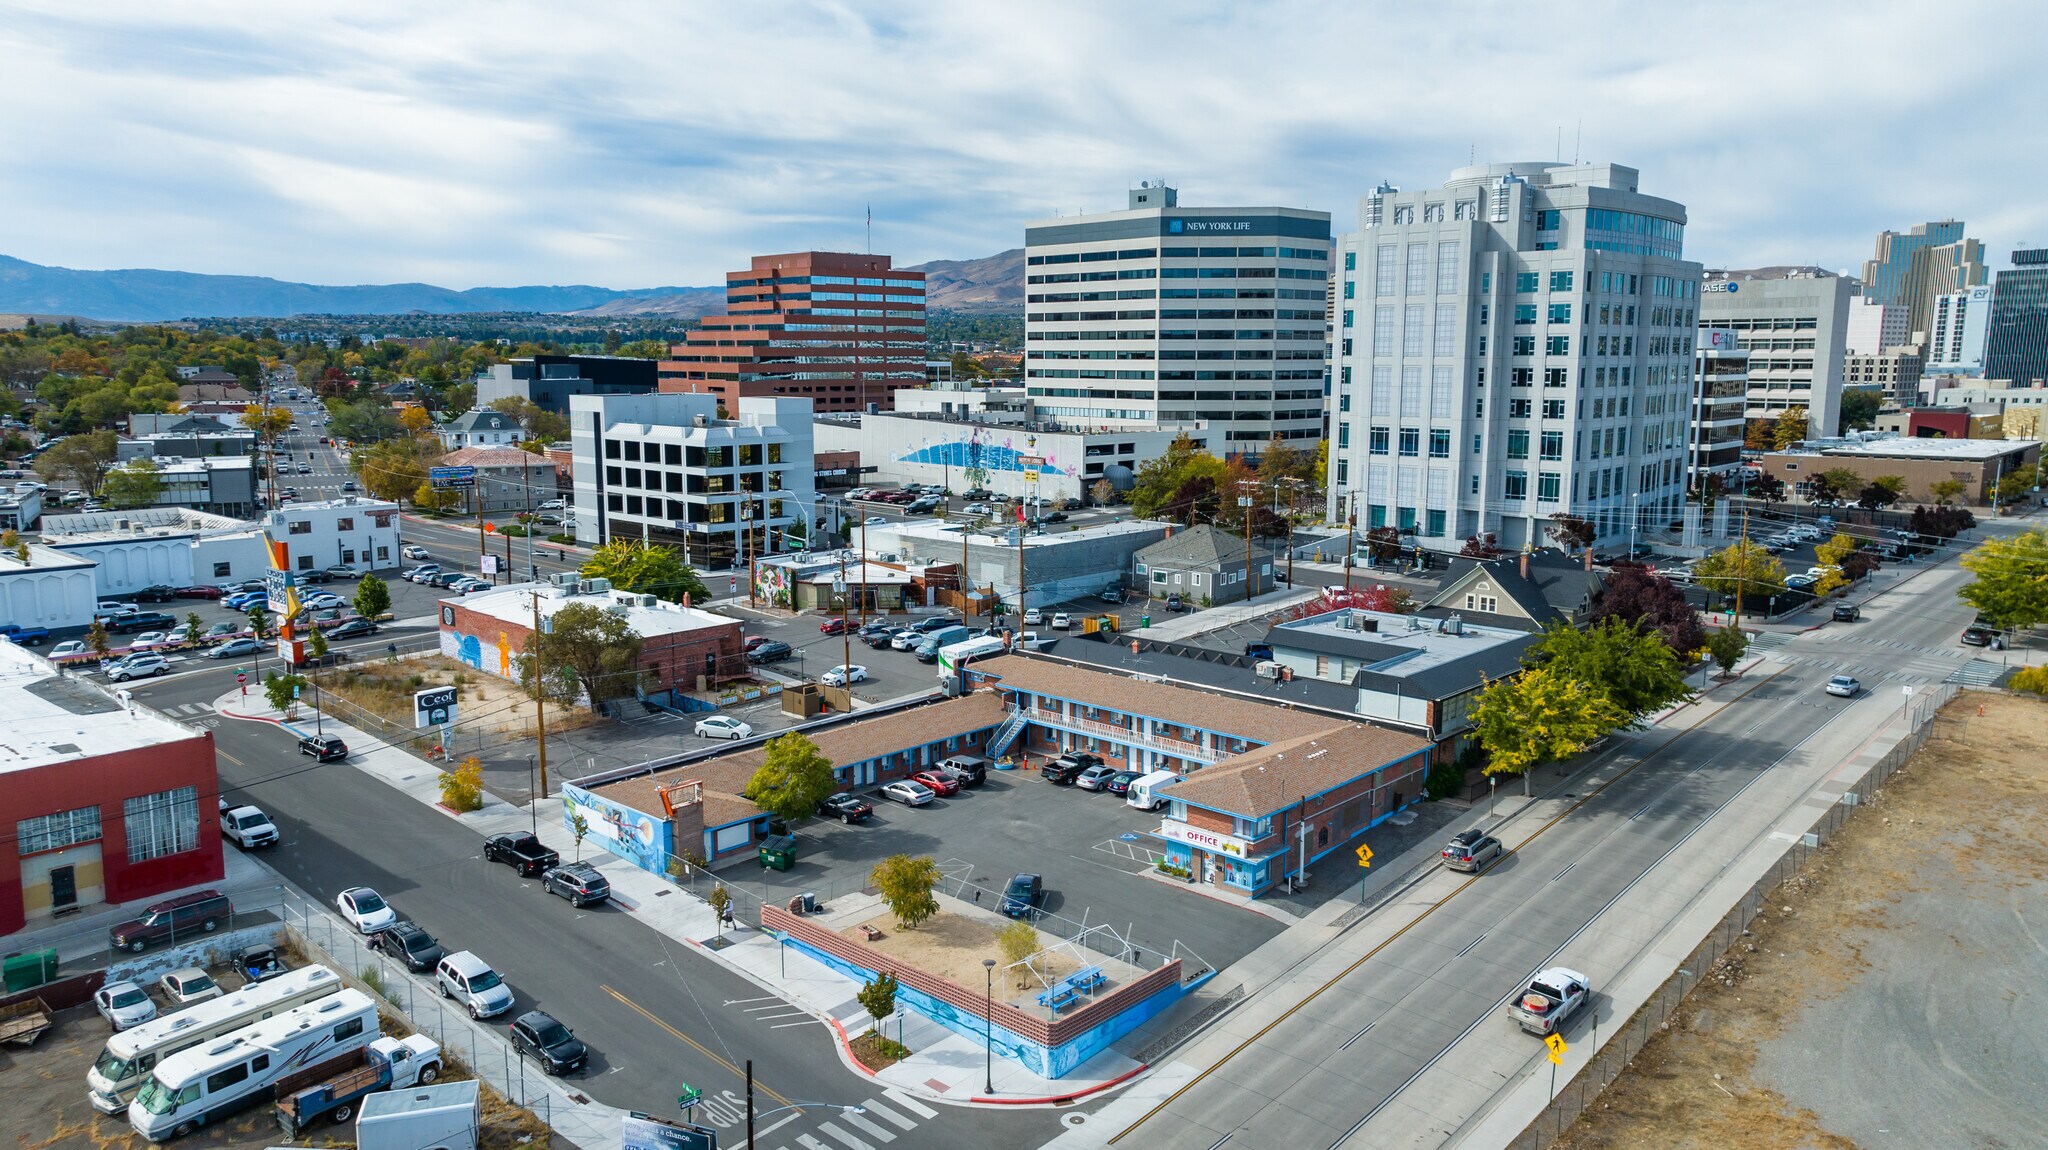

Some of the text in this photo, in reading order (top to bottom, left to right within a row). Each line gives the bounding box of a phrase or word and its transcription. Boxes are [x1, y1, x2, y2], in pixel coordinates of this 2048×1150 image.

[1187, 222, 1250, 231] NEW YORK LIFE
[421, 690, 453, 707] Ceol
[1187, 831, 1218, 847] OFFICE
[697, 1090, 758, 1128] STOP
[665, 1130, 692, 1142] chance.
